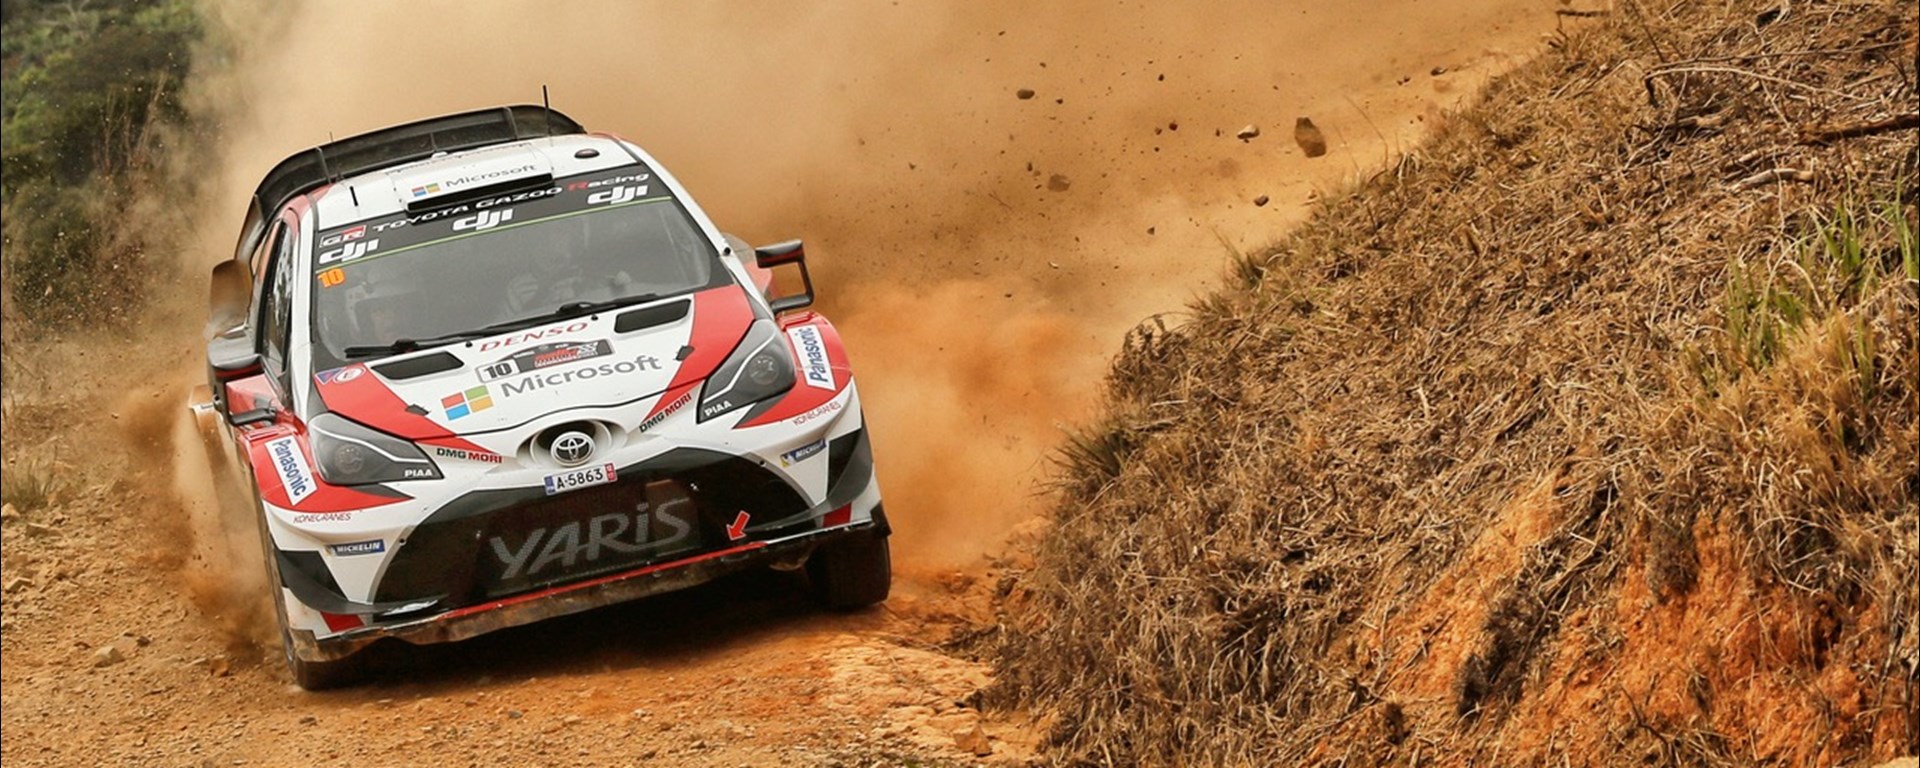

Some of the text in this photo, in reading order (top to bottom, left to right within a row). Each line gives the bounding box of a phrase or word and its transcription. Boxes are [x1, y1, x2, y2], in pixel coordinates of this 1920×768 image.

[445, 164, 537, 187] Microsoft
[373, 205, 469, 232] TOYOTA
[475, 187, 562, 209] GAZOO
[567, 172, 649, 191] Racing
[317, 268, 345, 288] 10
[479, 322, 588, 352] DENSO
[795, 327, 829, 383] Panasonic
[484, 362, 513, 379] 10
[501, 355, 662, 398] Microsoft
[639, 393, 692, 433] DMG MORI
[704, 400, 733, 417] PIAA
[436, 448, 502, 464] DMG MORI
[273, 438, 307, 497] Panasonic
[404, 468, 433, 477] PIAA
[293, 512, 352, 524] KONECRANES
[336, 541, 382, 553] MICHELIN
